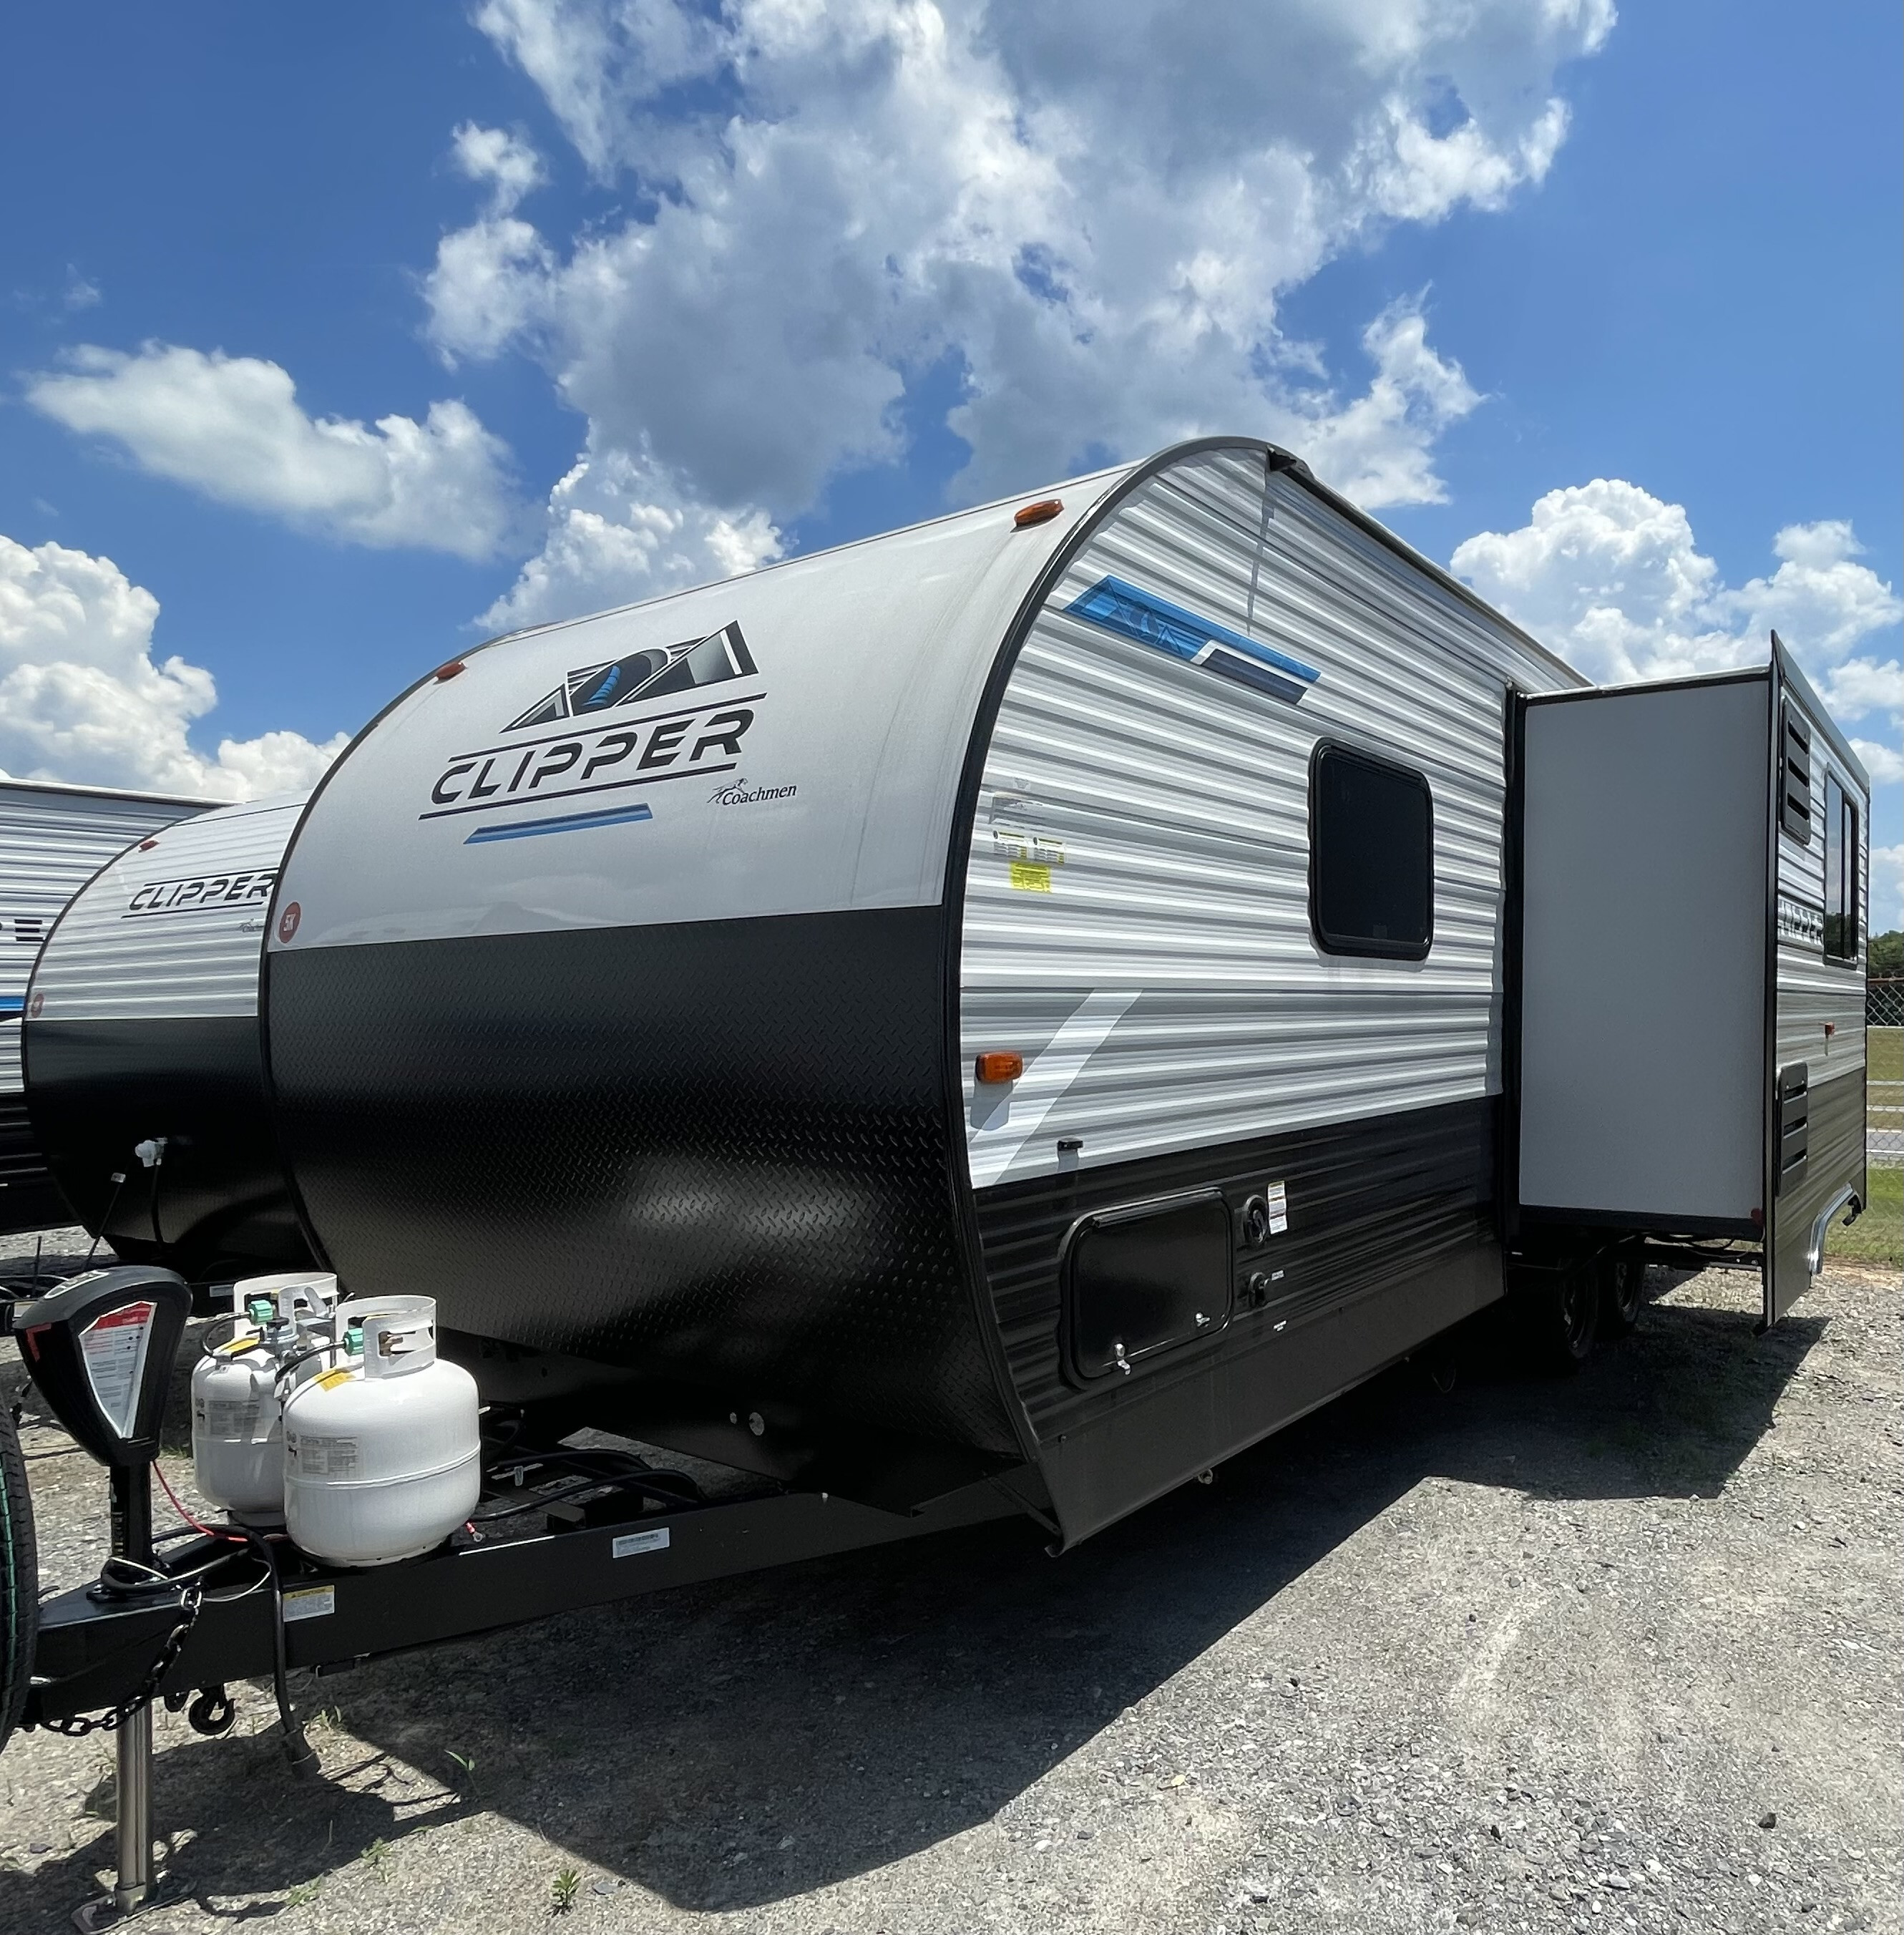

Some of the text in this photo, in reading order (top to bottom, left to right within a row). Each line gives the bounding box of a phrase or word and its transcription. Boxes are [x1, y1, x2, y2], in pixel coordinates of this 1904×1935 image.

[431, 709, 755, 805] CLIPPER
[723, 785, 797, 806] Coachmen
[129, 873, 277, 911] CLIPPER
